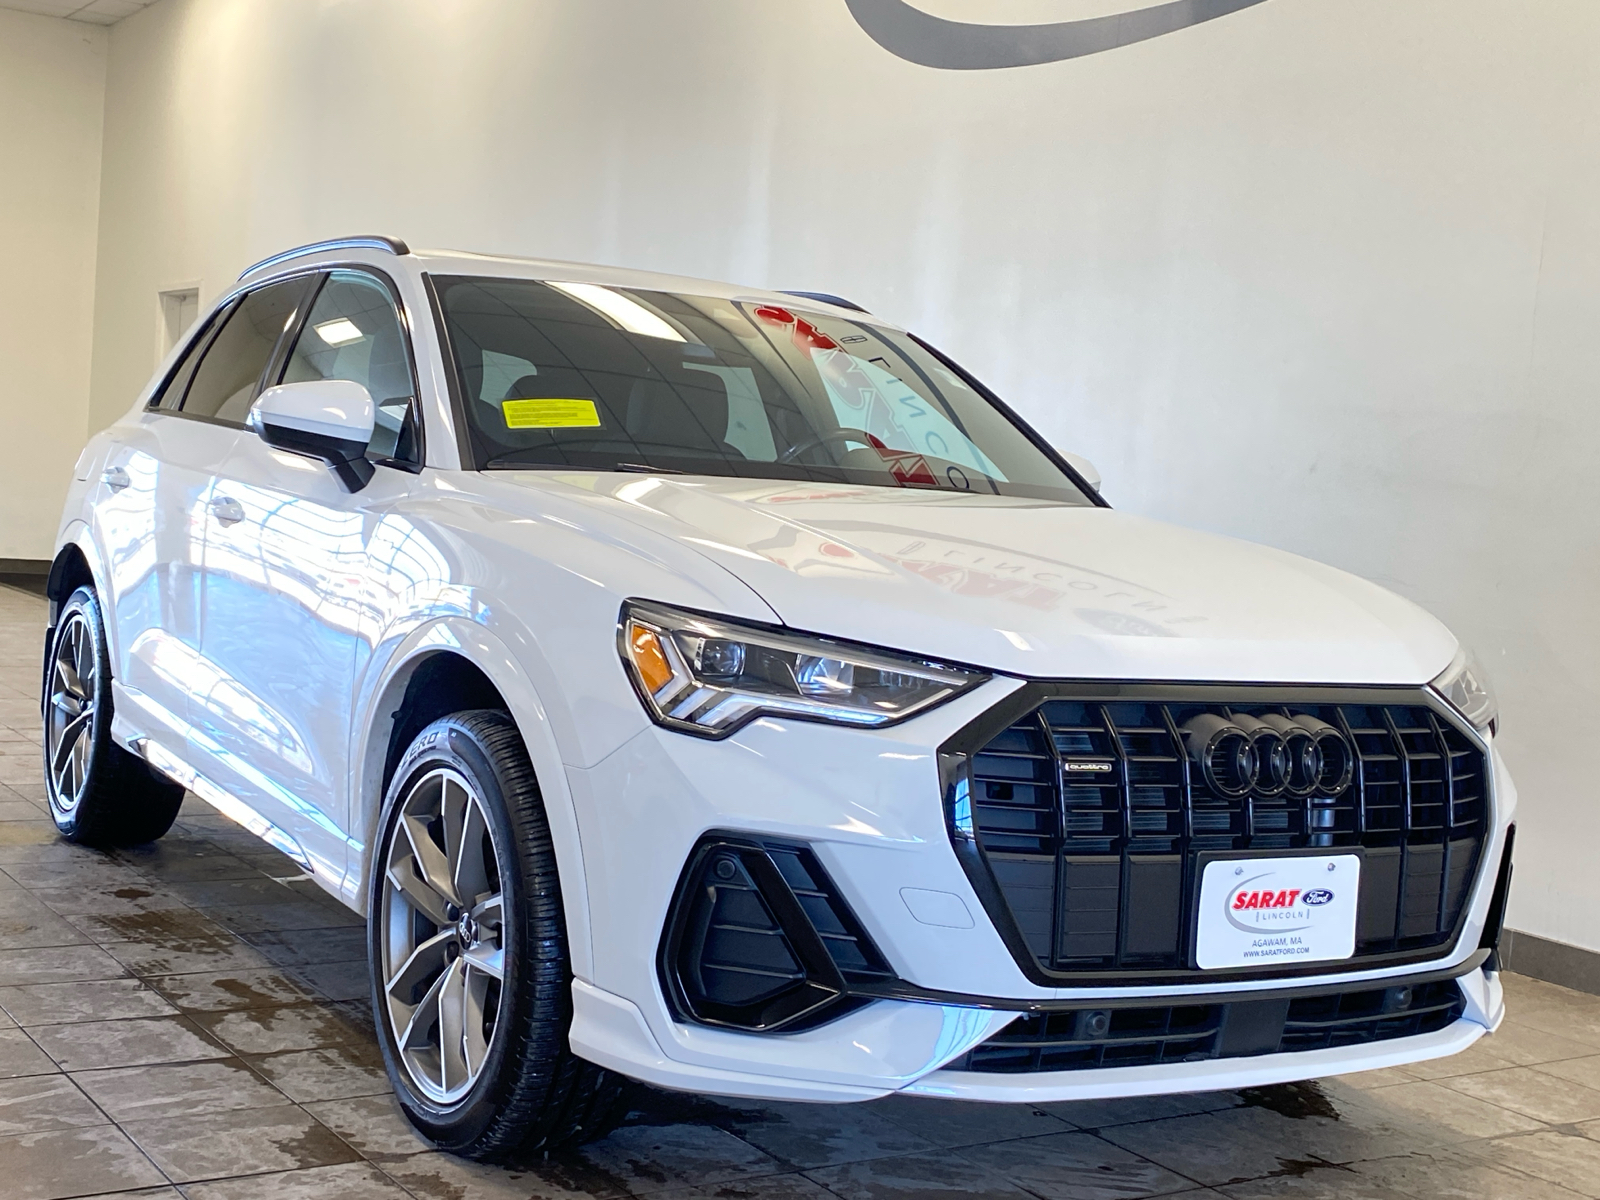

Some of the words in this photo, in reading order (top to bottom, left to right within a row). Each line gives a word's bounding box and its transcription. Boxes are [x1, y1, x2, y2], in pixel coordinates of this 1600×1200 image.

[1232, 888, 1302, 911] SARAT
[1305, 890, 1331, 904] Ford
[1262, 911, 1304, 921] LINCOLN
[1251, 938, 1288, 948] AGAWAM,
[1290, 936, 1303, 945] MA
[1243, 947, 1310, 958] WWW.SARATFORD.COM
